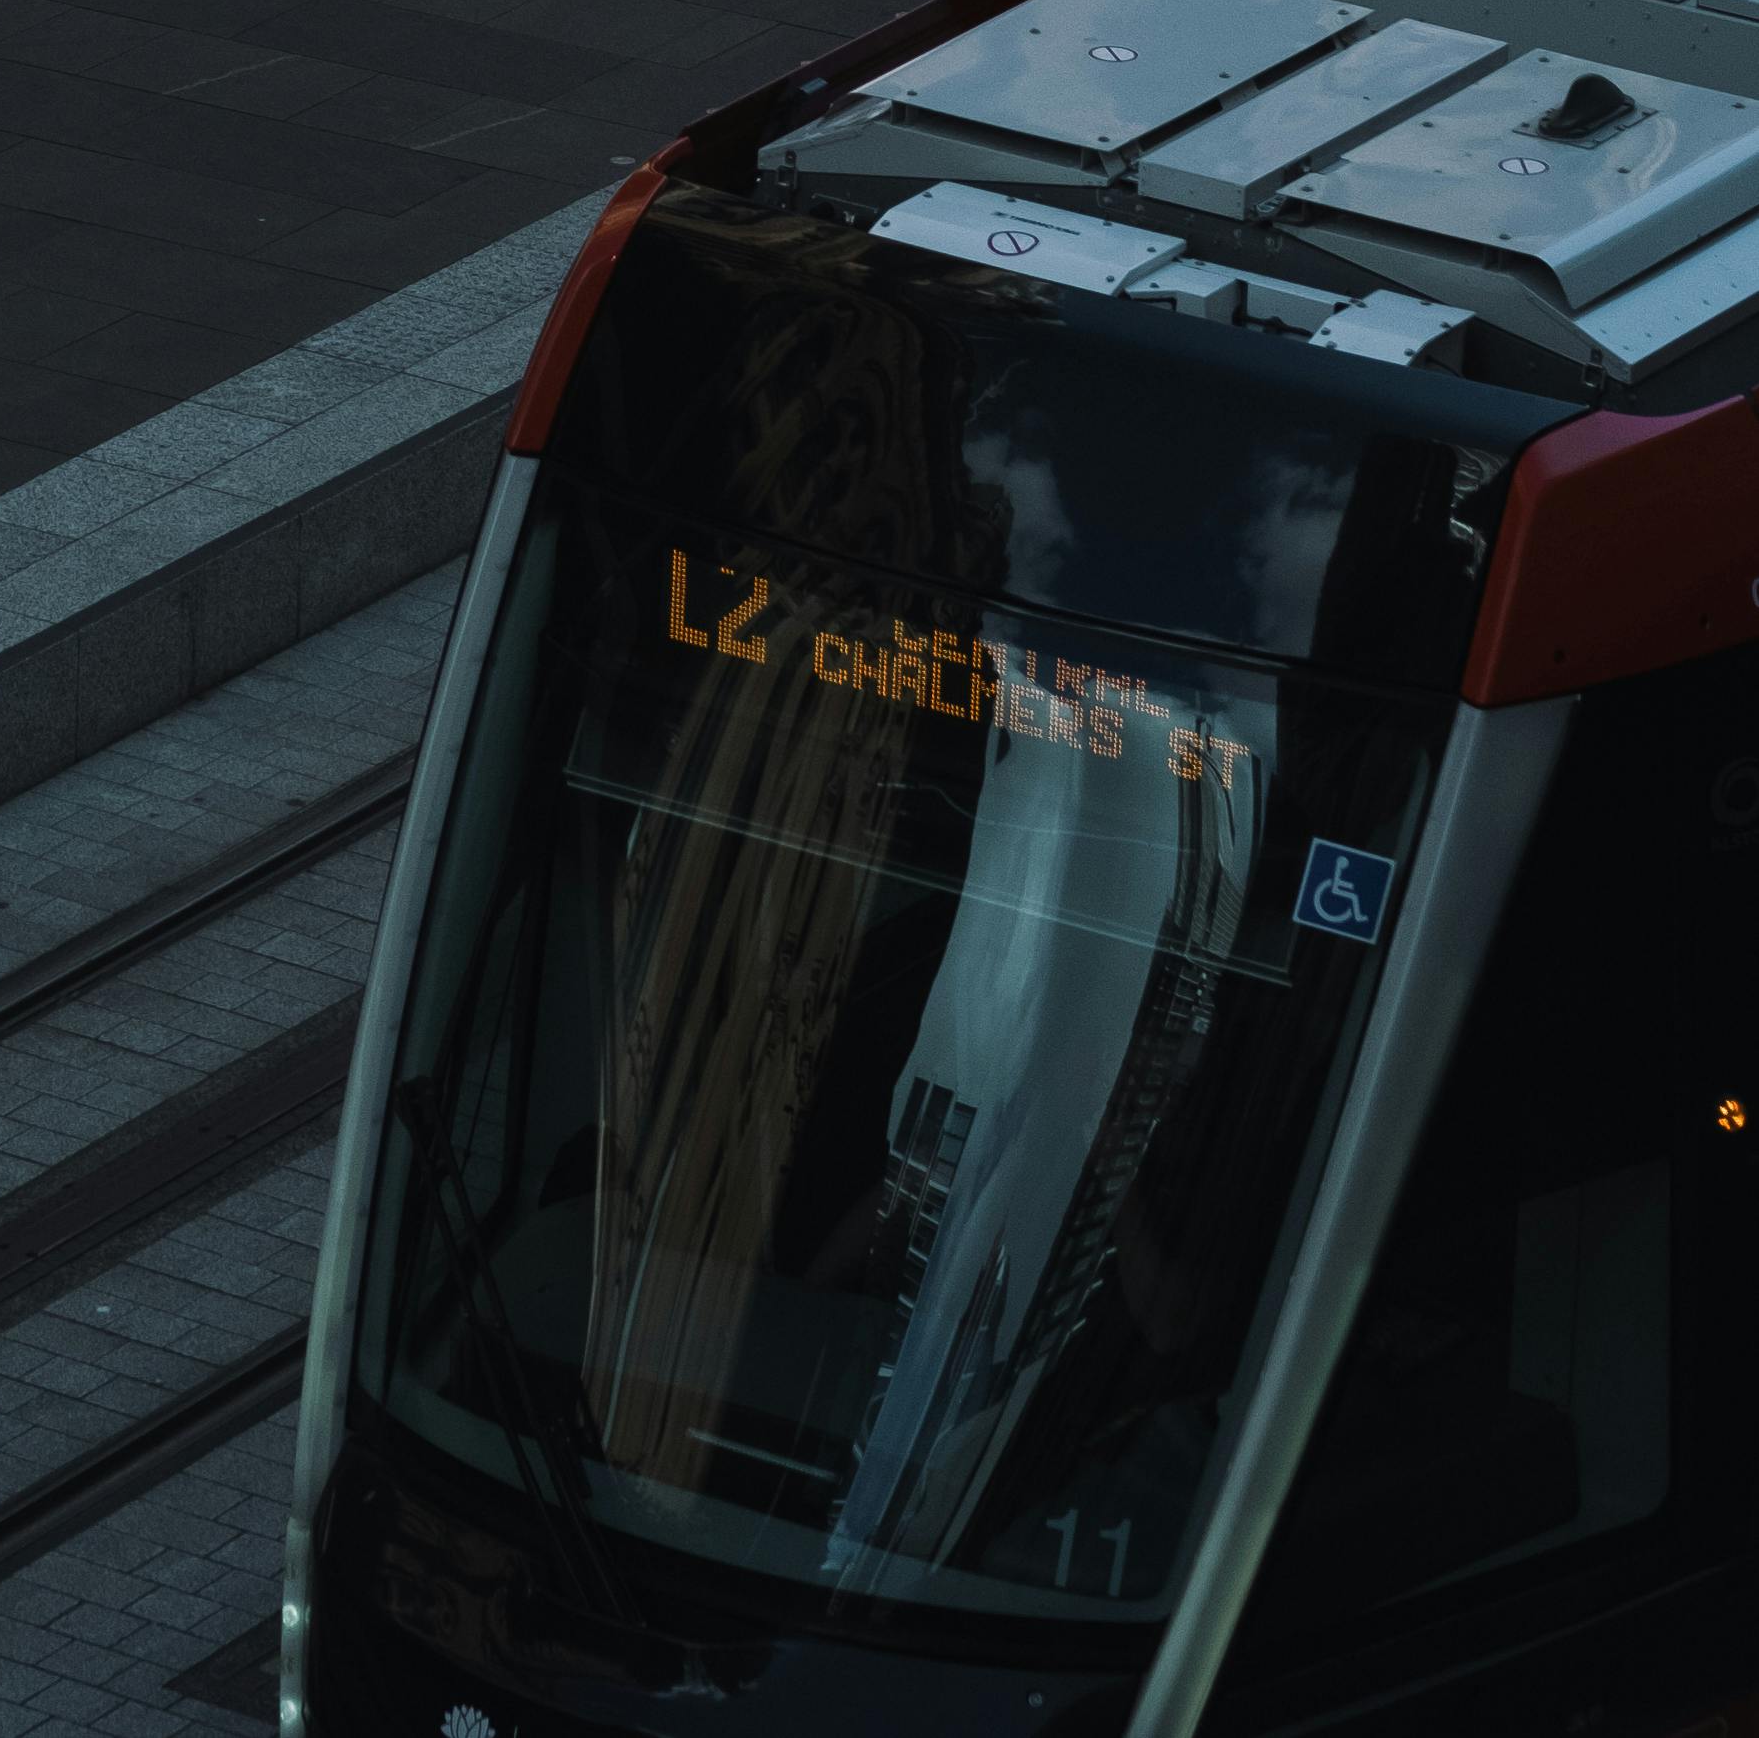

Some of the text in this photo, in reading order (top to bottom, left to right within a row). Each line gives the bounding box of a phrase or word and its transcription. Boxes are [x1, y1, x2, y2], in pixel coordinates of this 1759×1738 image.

[669, 548, 769, 664] L2
[813, 631, 1251, 791] CHALMERS ST
[1046, 1508, 1132, 1597] 11
